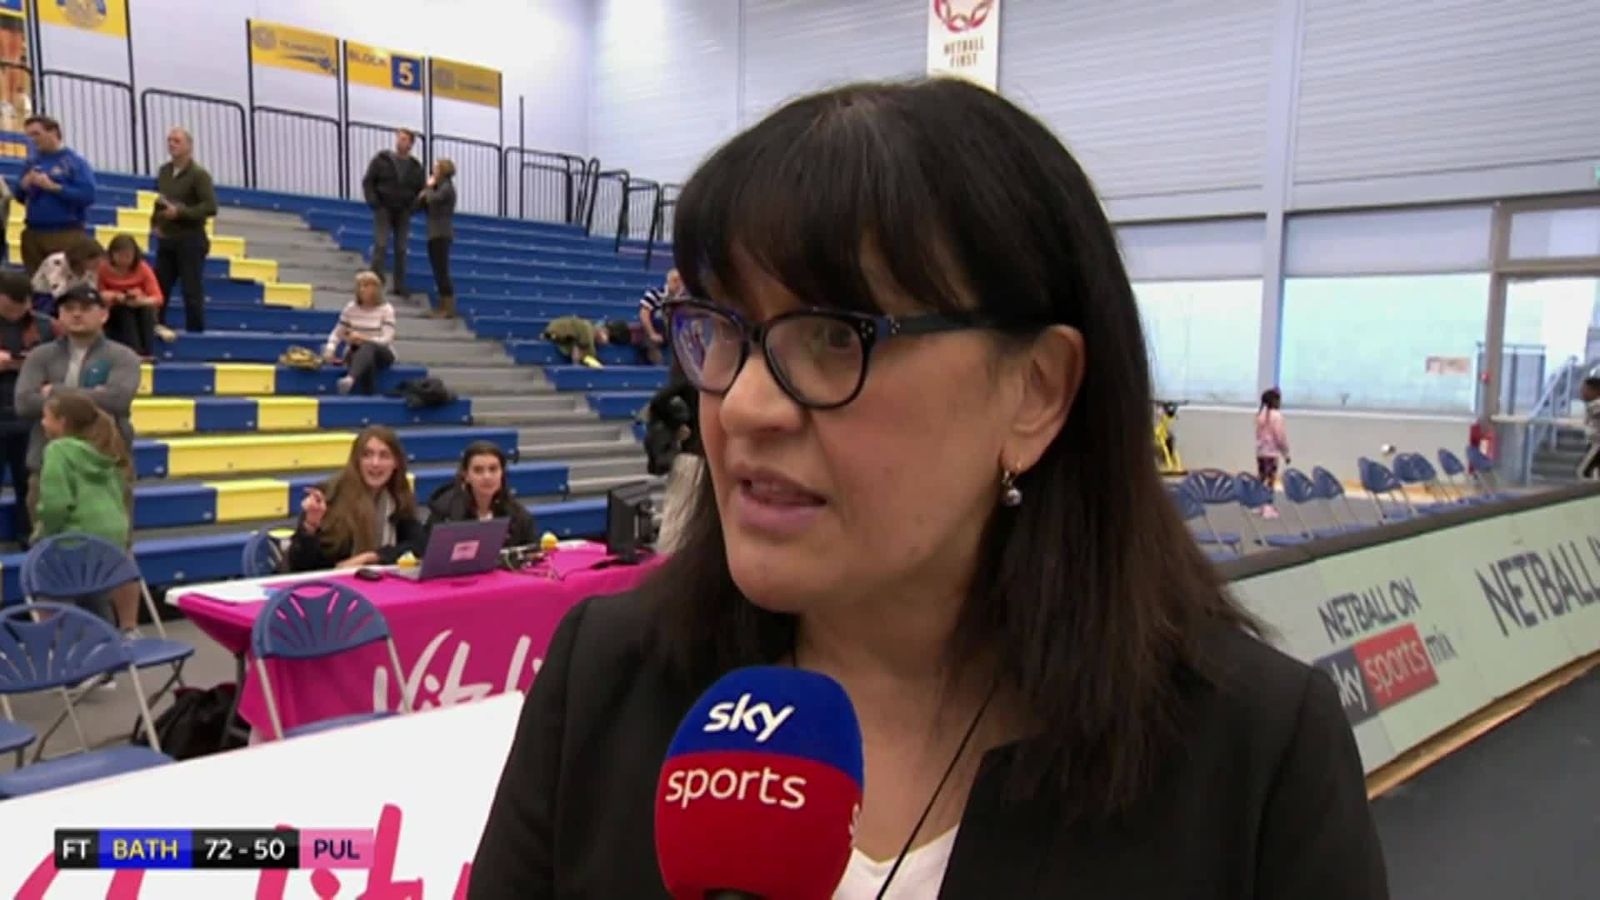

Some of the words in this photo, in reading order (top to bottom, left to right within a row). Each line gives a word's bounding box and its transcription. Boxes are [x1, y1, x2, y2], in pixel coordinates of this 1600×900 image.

[399, 61, 414, 86] 5
[1317, 584, 1397, 645] NETBALL
[1389, 576, 1423, 618] ON
[1473, 540, 1600, 638] NETBALL
[1362, 640, 1428, 697] sports
[703, 693, 795, 742] sky
[665, 766, 807, 810] sports
